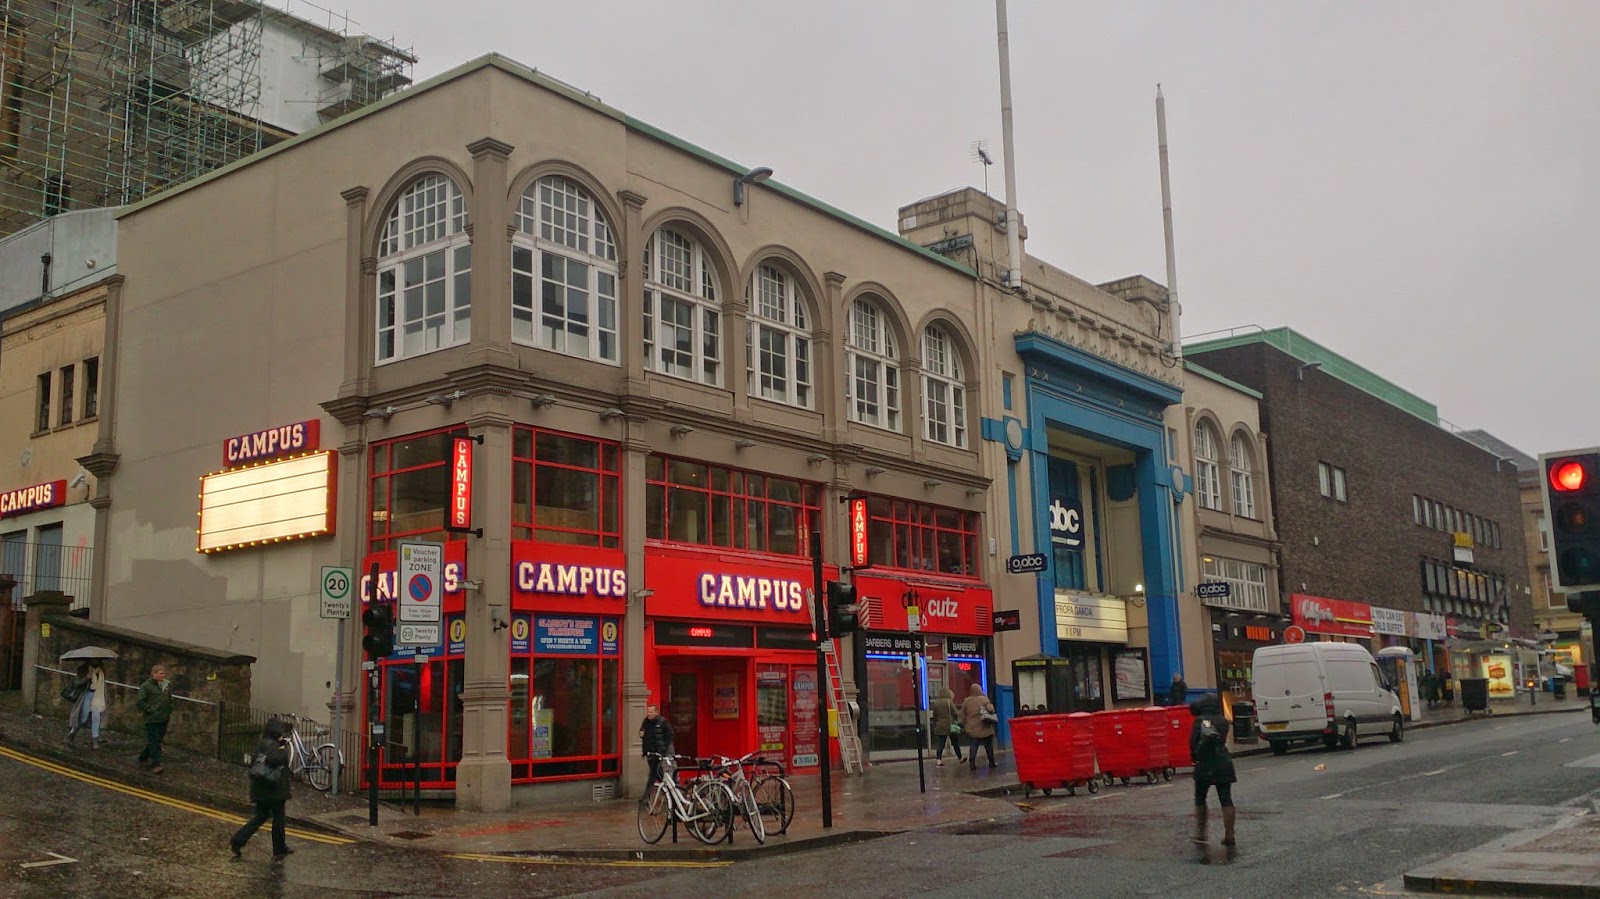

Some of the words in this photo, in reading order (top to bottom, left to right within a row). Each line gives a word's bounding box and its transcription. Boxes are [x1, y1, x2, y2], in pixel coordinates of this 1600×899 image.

[228, 423, 304, 462] CAMPUS
[456, 441, 468, 525] CAMPUS
[1, 483, 52, 513] CAMPUS
[855, 500, 865, 565] CAMPUS
[413, 548, 438, 556] Voucher
[413, 556, 437, 564] parking
[409, 563, 433, 572] ZONE
[519, 561, 626, 597] CAMPUS
[328, 578, 346, 591] 20
[700, 573, 802, 611] CAMPUS
[927, 596, 958, 618] cutz
[952, 641, 977, 652] BARBERS
